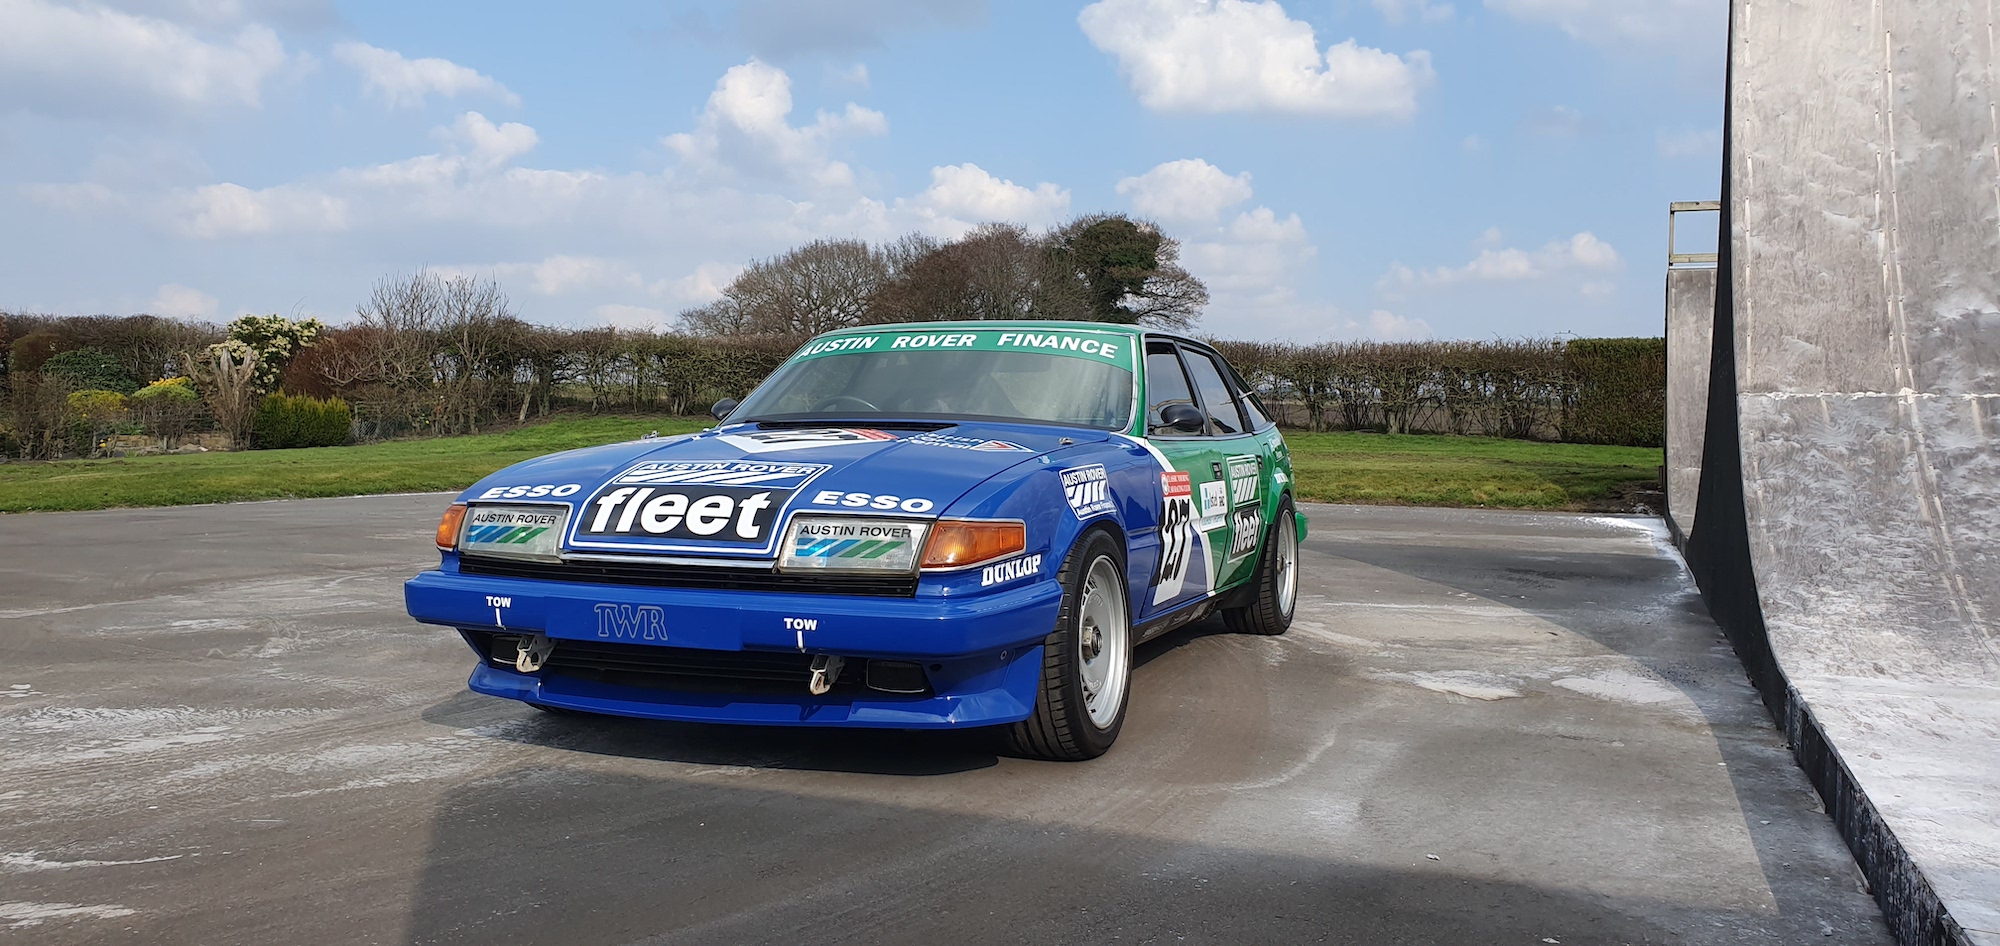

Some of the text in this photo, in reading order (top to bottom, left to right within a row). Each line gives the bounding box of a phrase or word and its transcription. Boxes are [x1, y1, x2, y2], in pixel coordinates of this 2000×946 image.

[797, 333, 1119, 359] AUSTIN ROVER FINANCE
[641, 462, 818, 475] AUSTIN ROVER
[1063, 467, 1106, 487] AUSTIN ROVER
[1230, 462, 1258, 479] AUSTIN ROVER
[479, 483, 582, 500] ESSO
[811, 490, 935, 513] ESSO
[472, 513, 557, 525] AUSTIN ROVER
[590, 486, 772, 539] fleet
[799, 525, 912, 538] AUSTIN ROVER
[1232, 508, 1260, 554] fleet
[1149, 498, 1191, 588] 127
[980, 553, 1042, 587] DUNLOP
[486, 595, 512, 608] TOW
[593, 603, 669, 641] TWR
[783, 617, 818, 631] TOW
